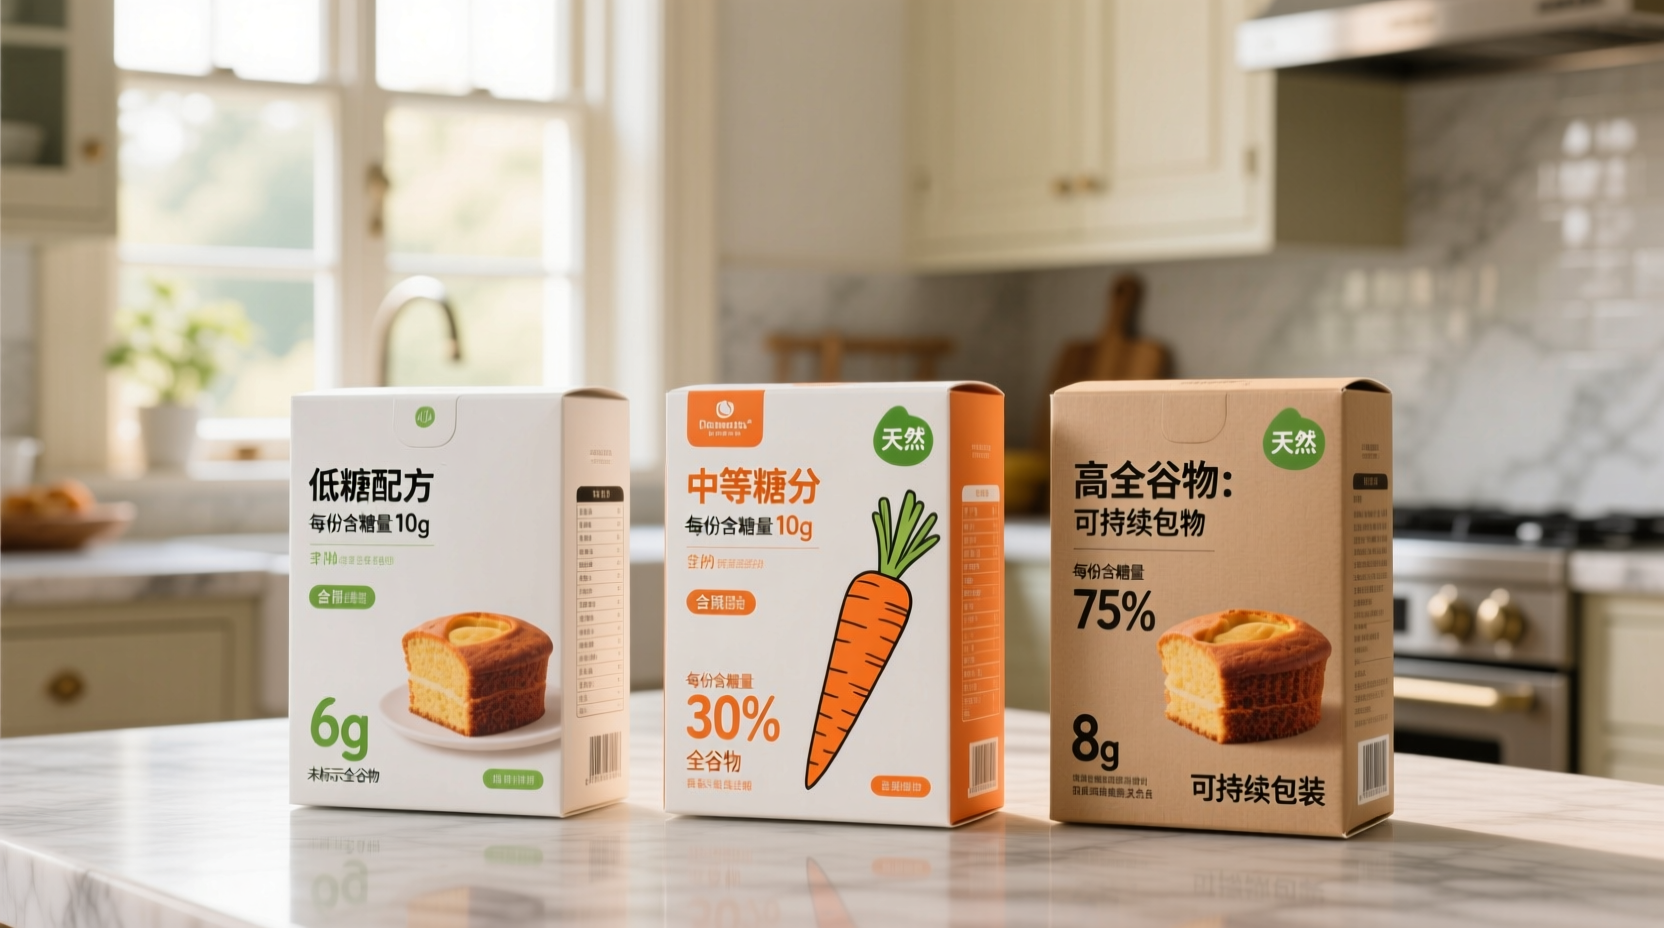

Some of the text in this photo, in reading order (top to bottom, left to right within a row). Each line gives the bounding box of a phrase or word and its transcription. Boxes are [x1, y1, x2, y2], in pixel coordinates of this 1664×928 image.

[881, 426, 926, 451] 天然
[1271, 429, 1317, 455] 天然
[308, 467, 435, 503] 低糖配方
[687, 466, 821, 505] 中等糖分
[1073, 507, 1206, 537] 可持续包物
[1073, 588, 1156, 632] 75%
[310, 696, 369, 762] 6g
[686, 693, 781, 742] 30%
[1071, 713, 1119, 771] 8g
[686, 749, 742, 773] 全谷物
[1190, 773, 1326, 807] 可持续包装
